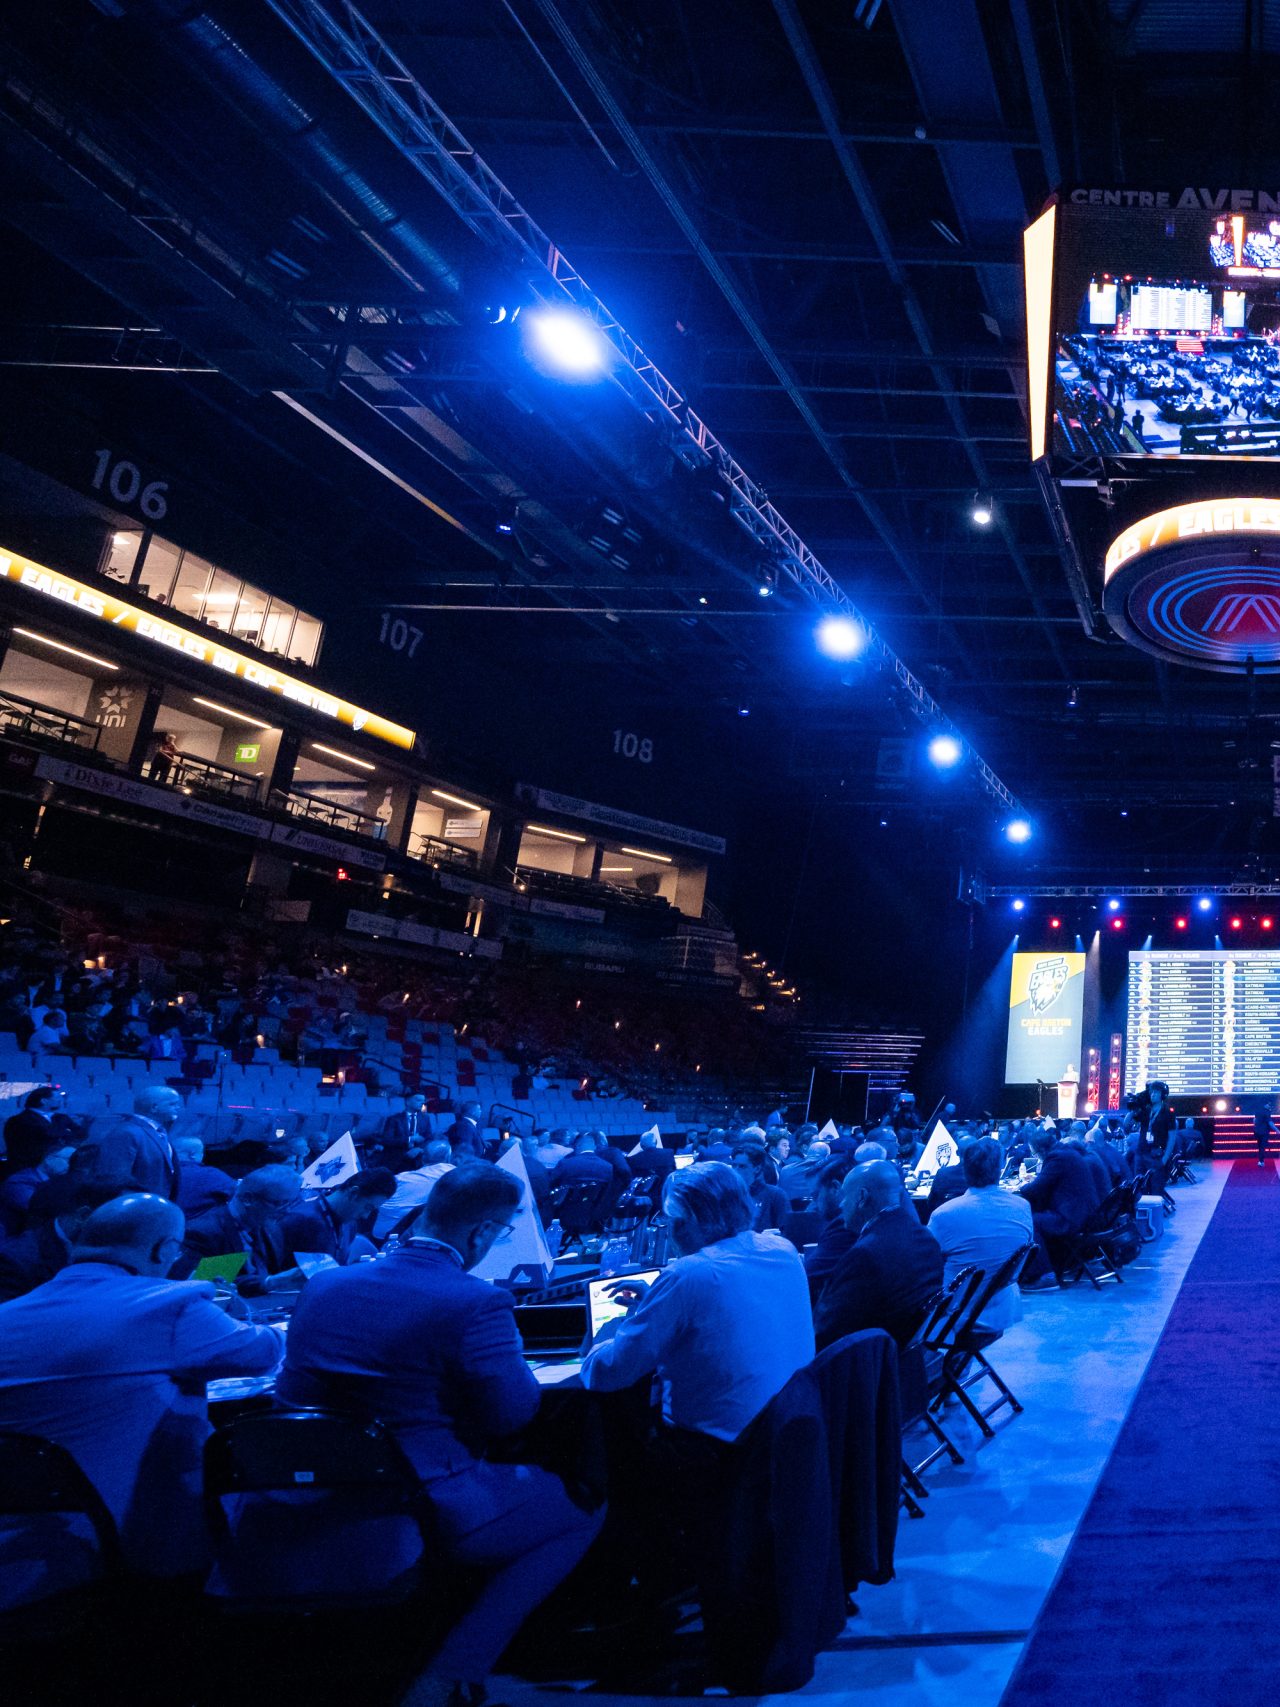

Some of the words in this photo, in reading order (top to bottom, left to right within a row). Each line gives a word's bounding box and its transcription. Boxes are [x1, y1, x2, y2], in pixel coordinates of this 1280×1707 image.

[1070, 188, 1170, 209] CENTRE
[90, 448, 170, 521] 106
[19, 565, 106, 617] EAGLES
[135, 616, 207, 661] EAGLES
[379, 611, 425, 659] 107
[95, 713, 127, 729] UNI
[240, 747, 257, 760] TD
[612, 729, 655, 764] 108
[1027, 1026, 1064, 1036] EAGLES
